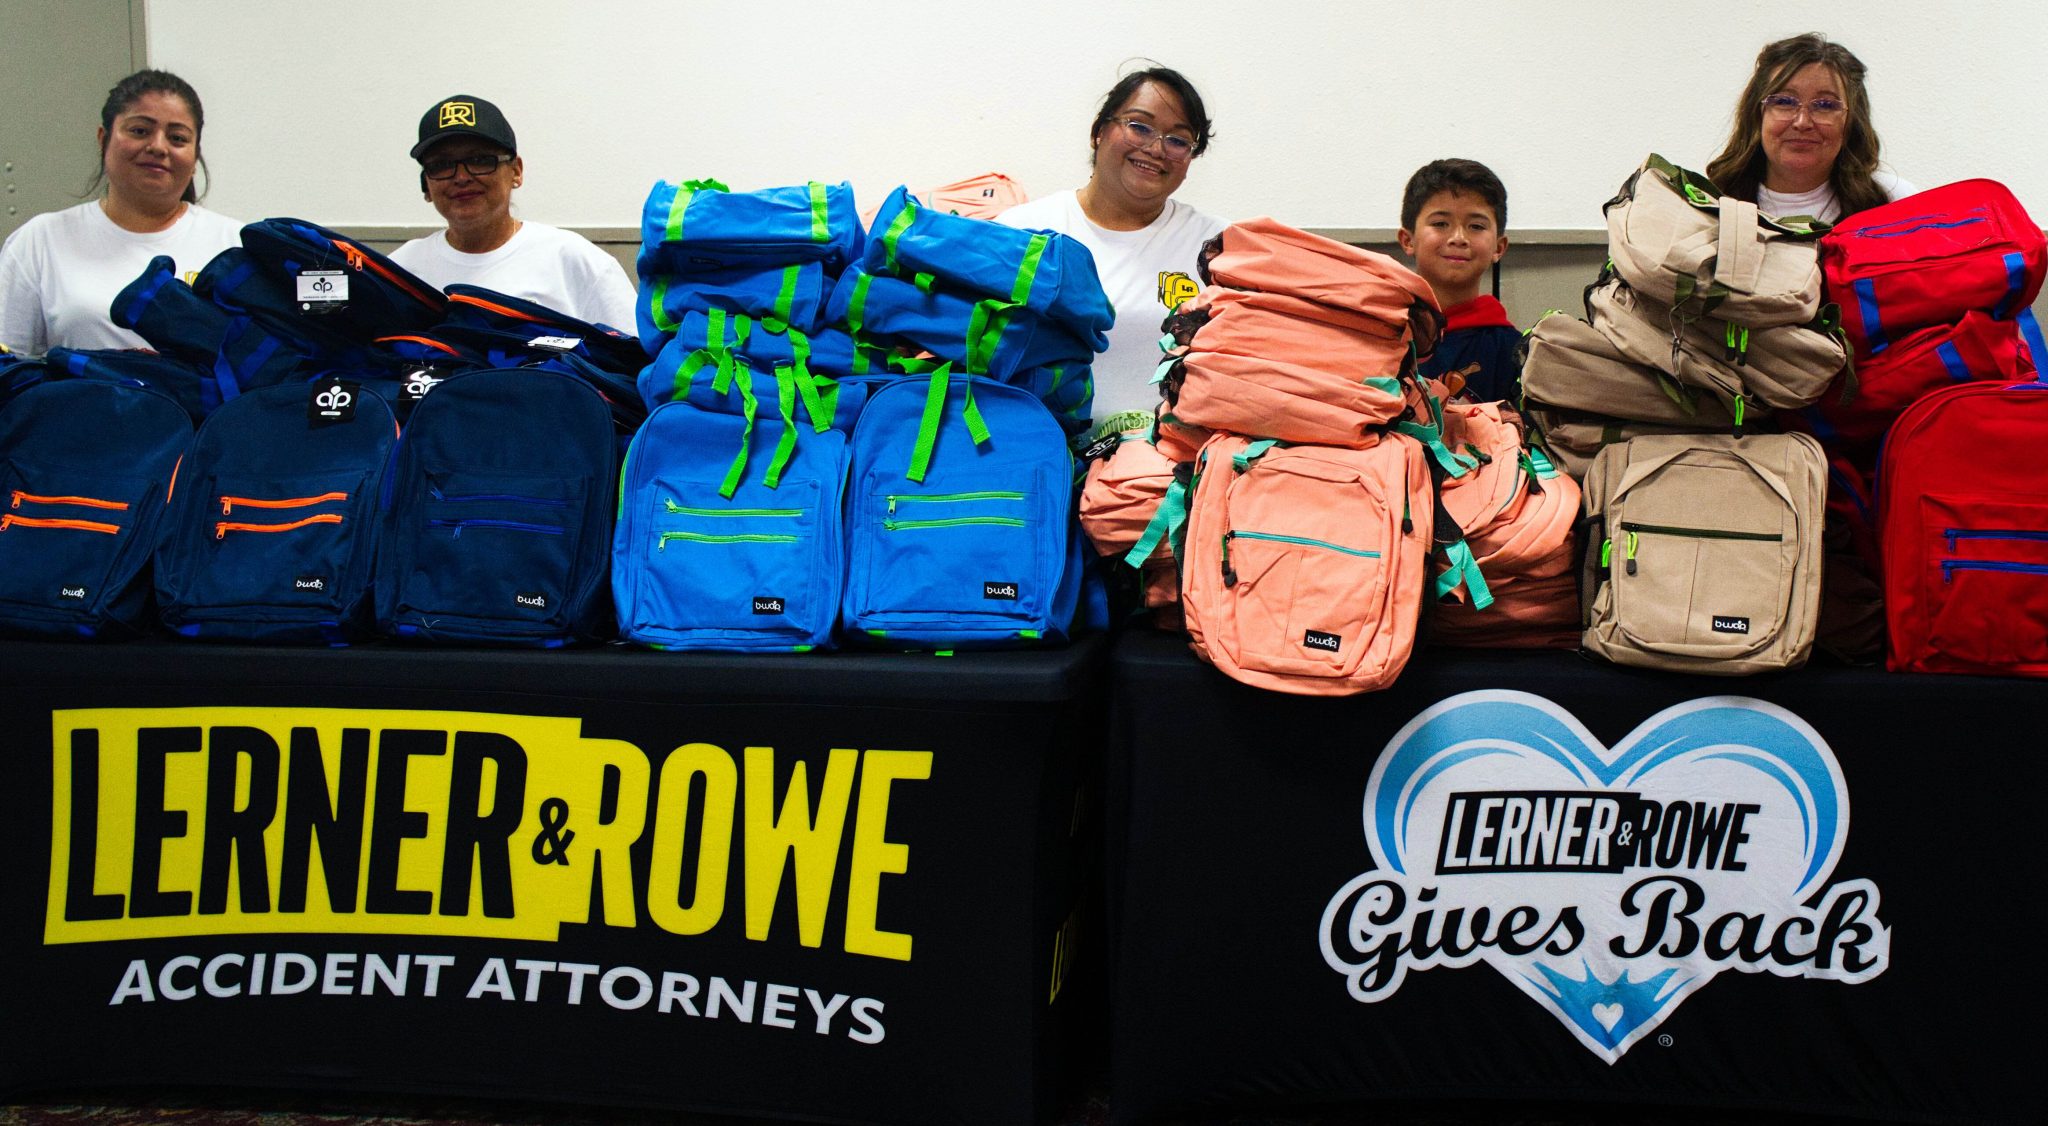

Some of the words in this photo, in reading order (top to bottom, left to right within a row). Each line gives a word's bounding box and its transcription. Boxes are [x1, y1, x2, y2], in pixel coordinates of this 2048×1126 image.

[1181, 284, 1194, 293] LR
[64, 725, 528, 922] LERNER
[531, 797, 575, 866] &
[562, 738, 934, 962] ROWE
[1443, 796, 1620, 868] LERNER
[1627, 799, 1761, 872] ROWE
[1330, 879, 1585, 992] Gives
[1609, 875, 1878, 973] Back
[109, 952, 456, 1006] ACCIDENT
[466, 957, 886, 1045] ATTORNEYS
